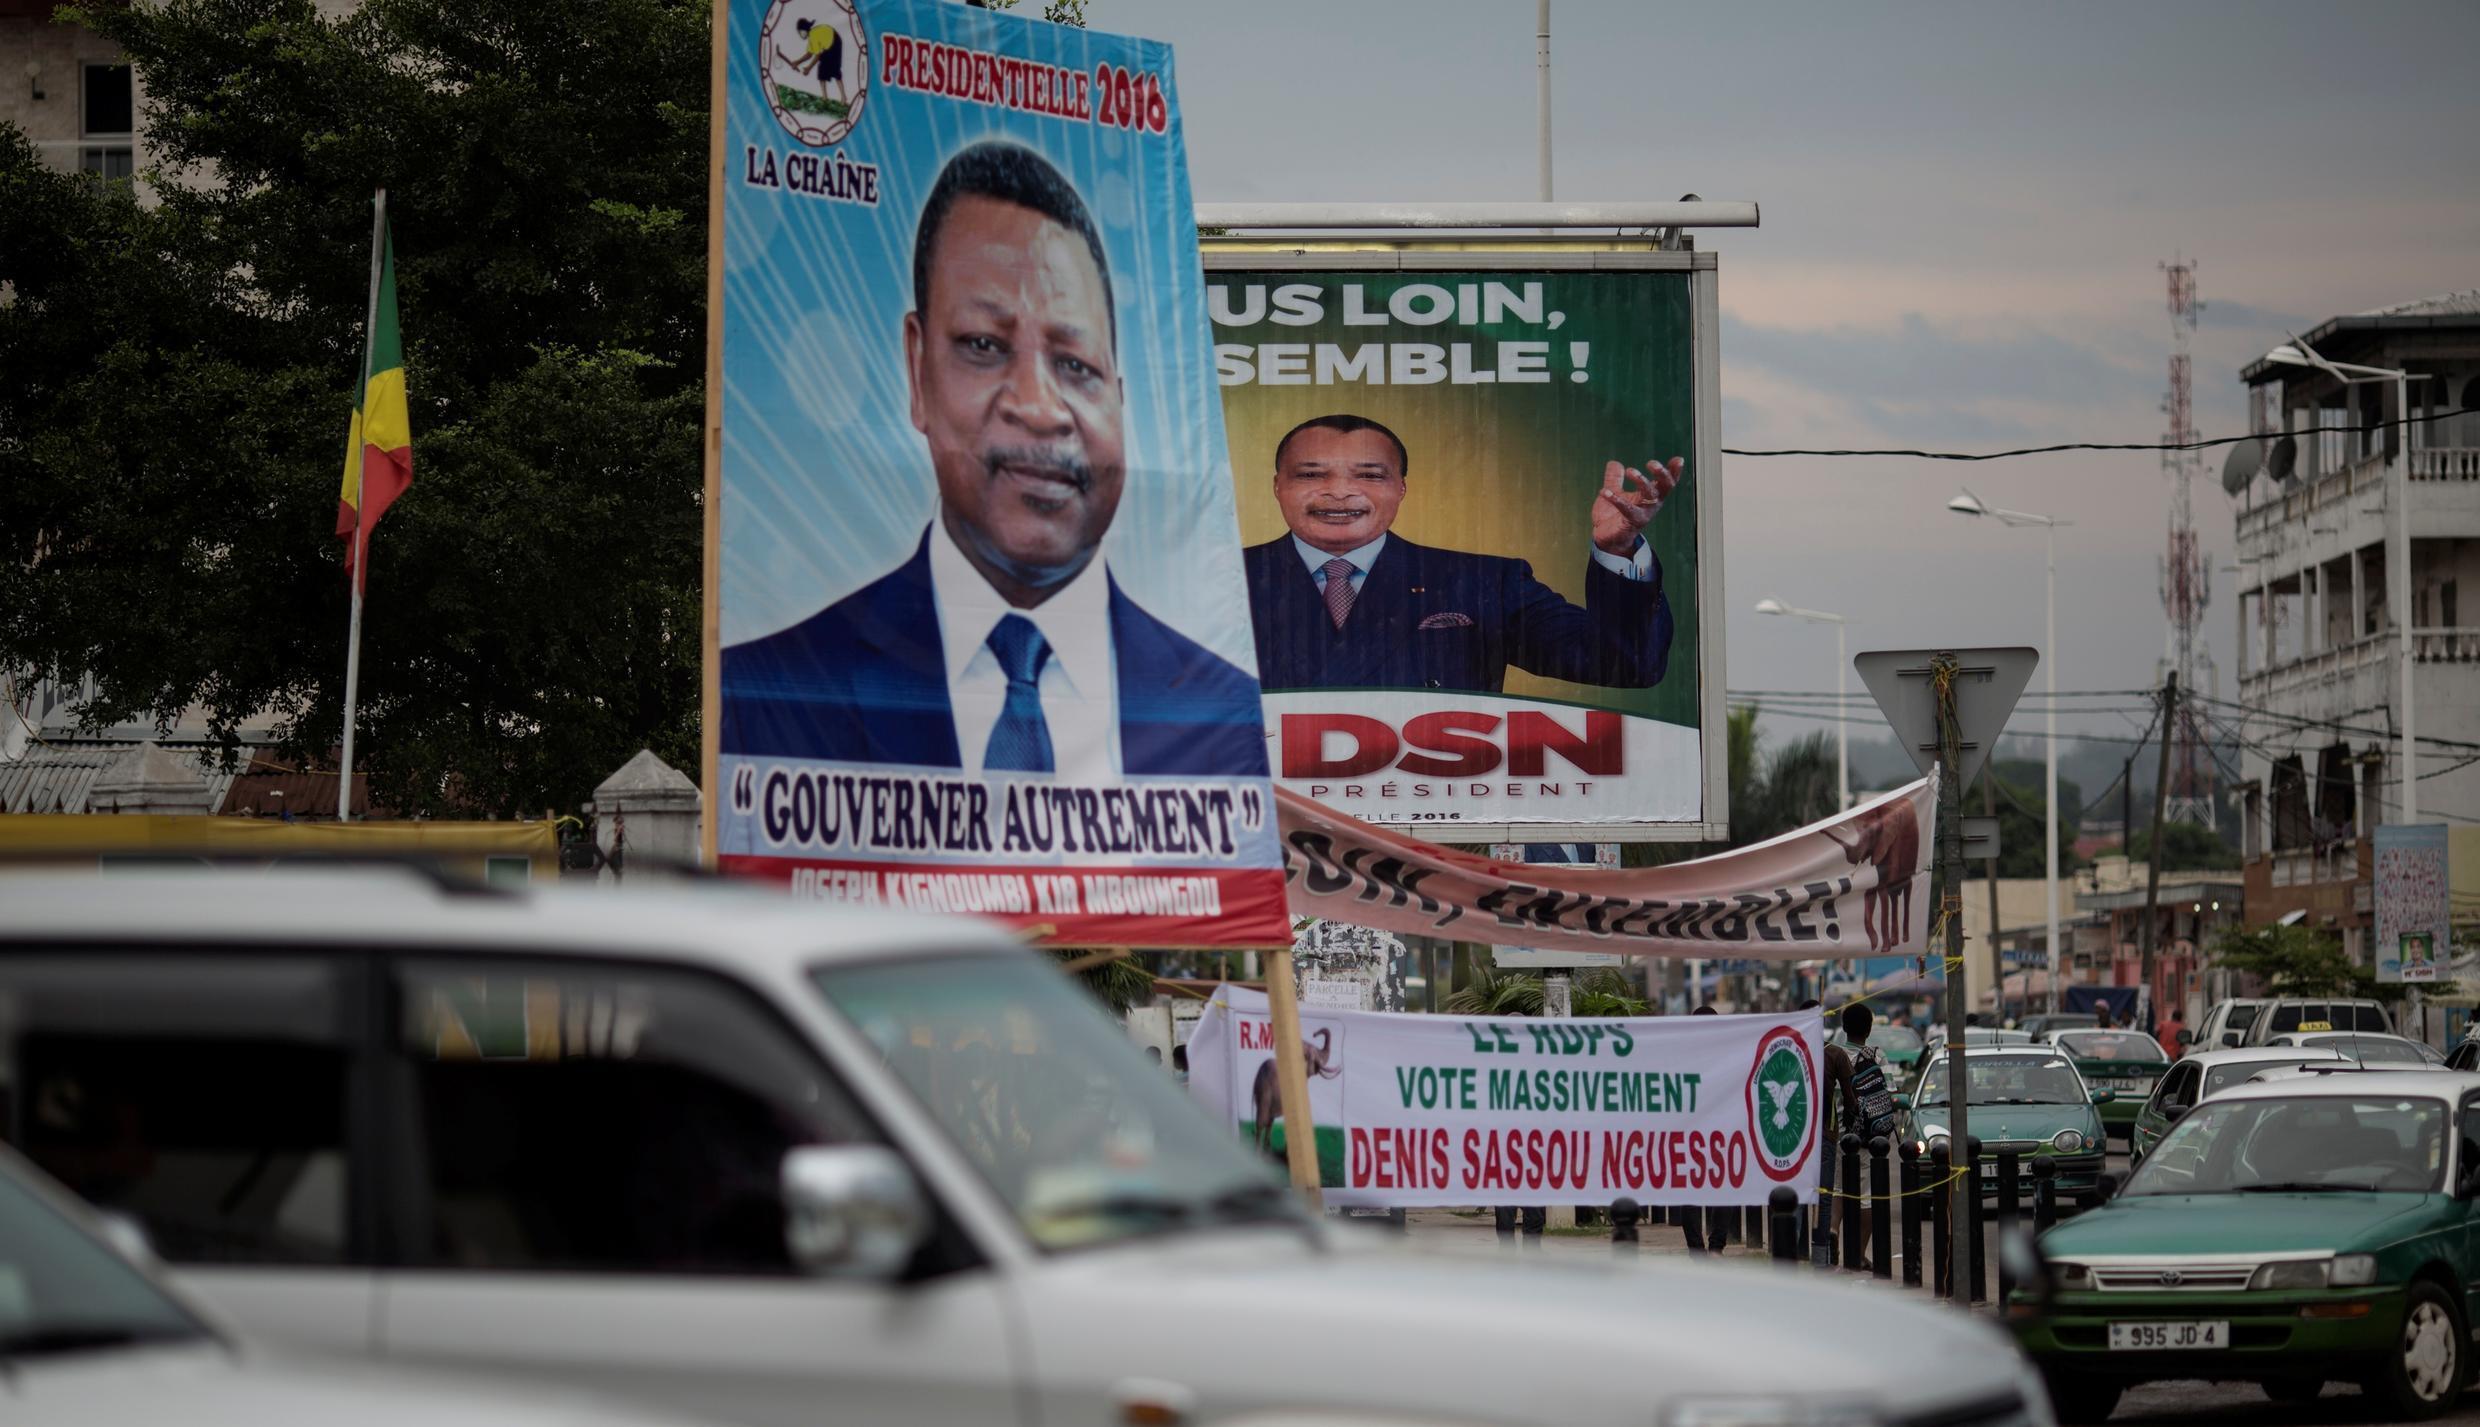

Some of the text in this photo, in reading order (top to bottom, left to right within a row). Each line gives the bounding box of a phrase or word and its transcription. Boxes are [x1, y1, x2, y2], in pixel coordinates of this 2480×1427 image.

[881, 34, 1168, 135] PRESIDENTIELLE 2016
[747, 146, 878, 203] LA CHAÎNE
[1208, 281, 1566, 331] US LOIN,
[1281, 710, 1623, 778] DSN
[1311, 780, 1594, 798] PRÉSIDENT
[1411, 812, 1461, 821] 2016
[885, 872, 1031, 914] KIGNOUMBI
[1083, 876, 1223, 917] MBOUNGOU
[1396, 1065, 1477, 1110] VOTE
[1489, 1067, 1702, 1113] MASSIVEMENT
[1351, 1126, 1747, 1191] DENIS SASSOU NGUESSO
[2130, 1325, 2215, 1346] 995 JD 4
